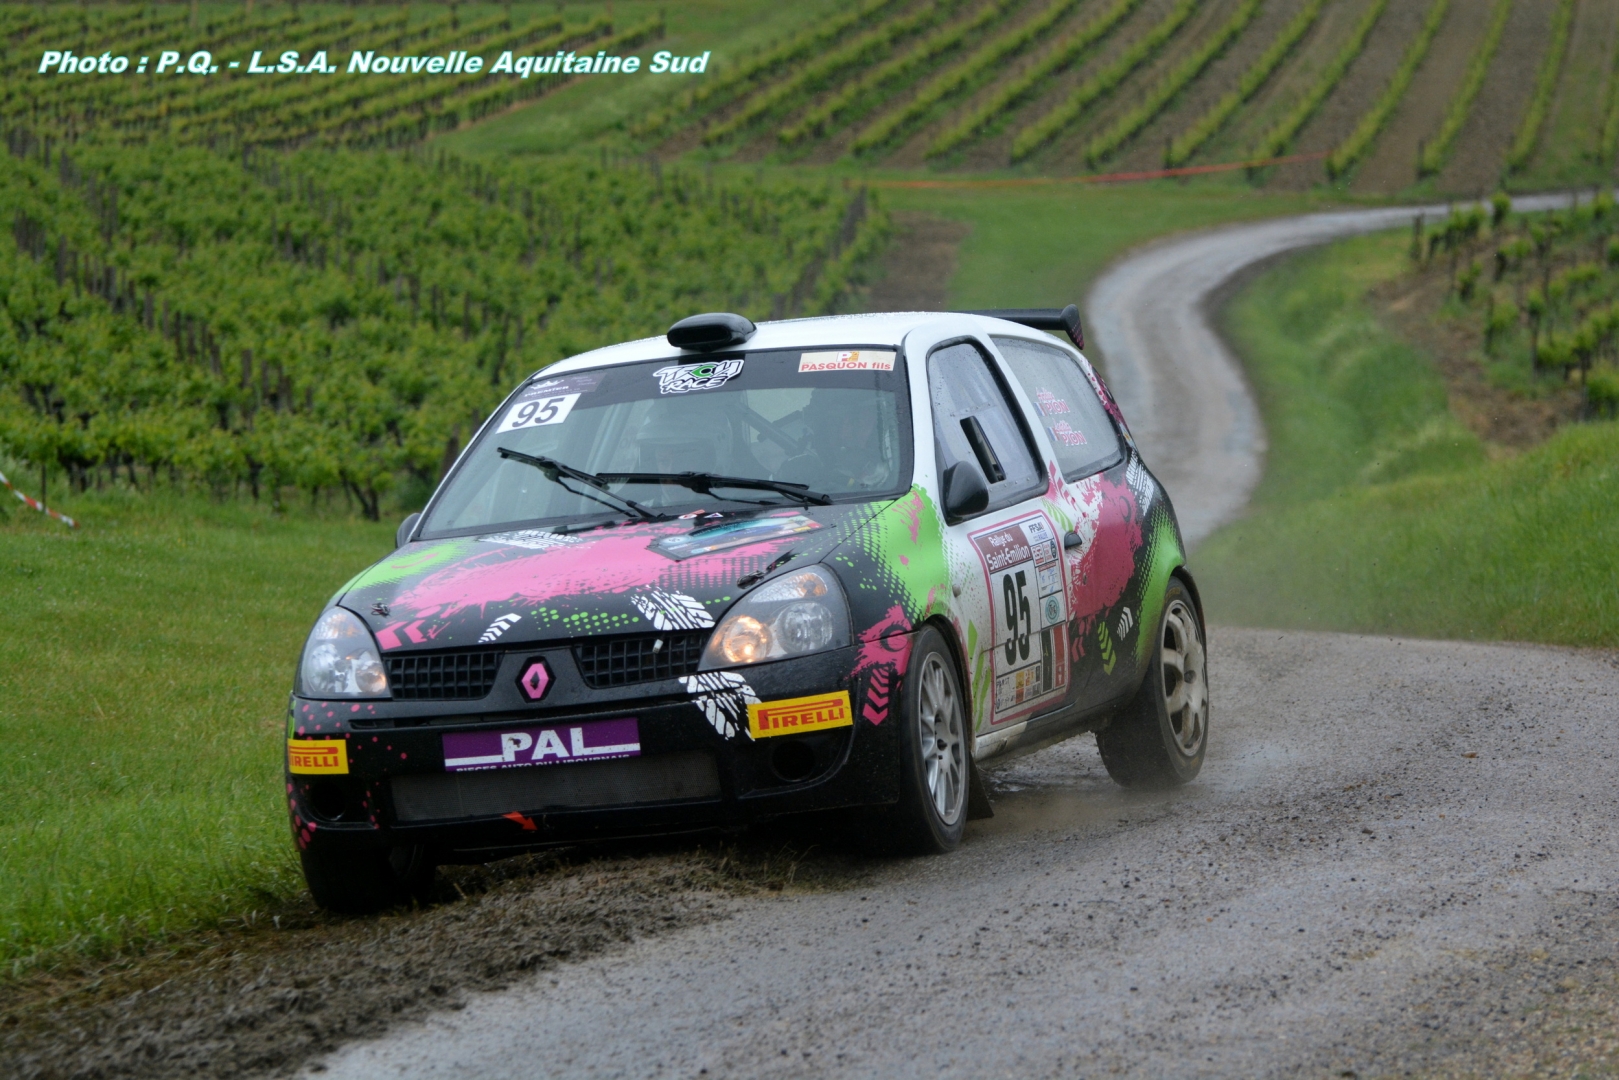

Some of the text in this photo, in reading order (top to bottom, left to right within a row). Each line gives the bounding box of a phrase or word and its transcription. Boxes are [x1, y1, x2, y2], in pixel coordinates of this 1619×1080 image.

[801, 362, 891, 371] PASQUON fils
[661, 375, 729, 393] RACE
[512, 396, 566, 428] 95
[988, 534, 1007, 547] Rallye
[1002, 570, 1031, 665] 95
[757, 699, 844, 730] PIRELLI
[289, 746, 339, 768] IRELLI
[501, 727, 595, 762] PAL
